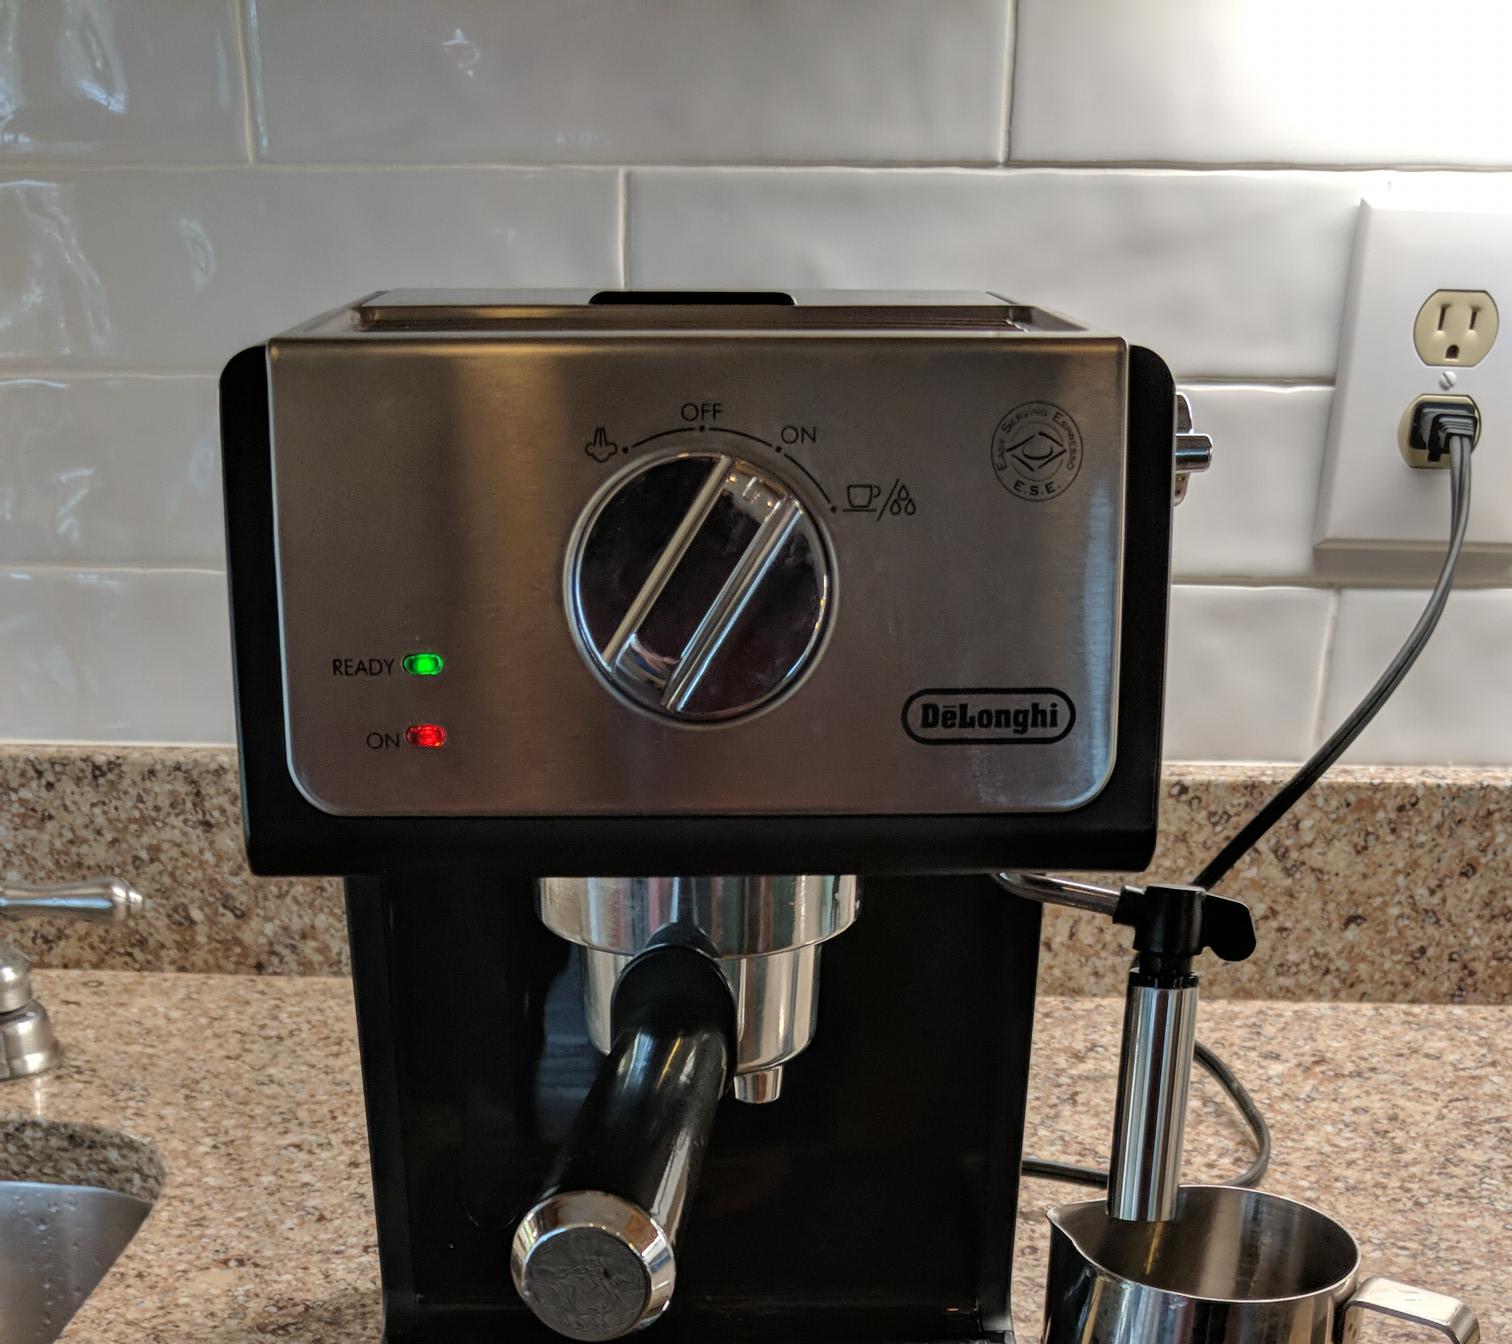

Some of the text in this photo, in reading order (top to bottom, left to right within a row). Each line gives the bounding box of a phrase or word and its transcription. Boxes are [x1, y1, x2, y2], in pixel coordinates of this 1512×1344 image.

[681, 402, 722, 422] OFF
[780, 425, 816, 444] ON
[332, 658, 395, 676] READY
[366, 732, 400, 749] ON
